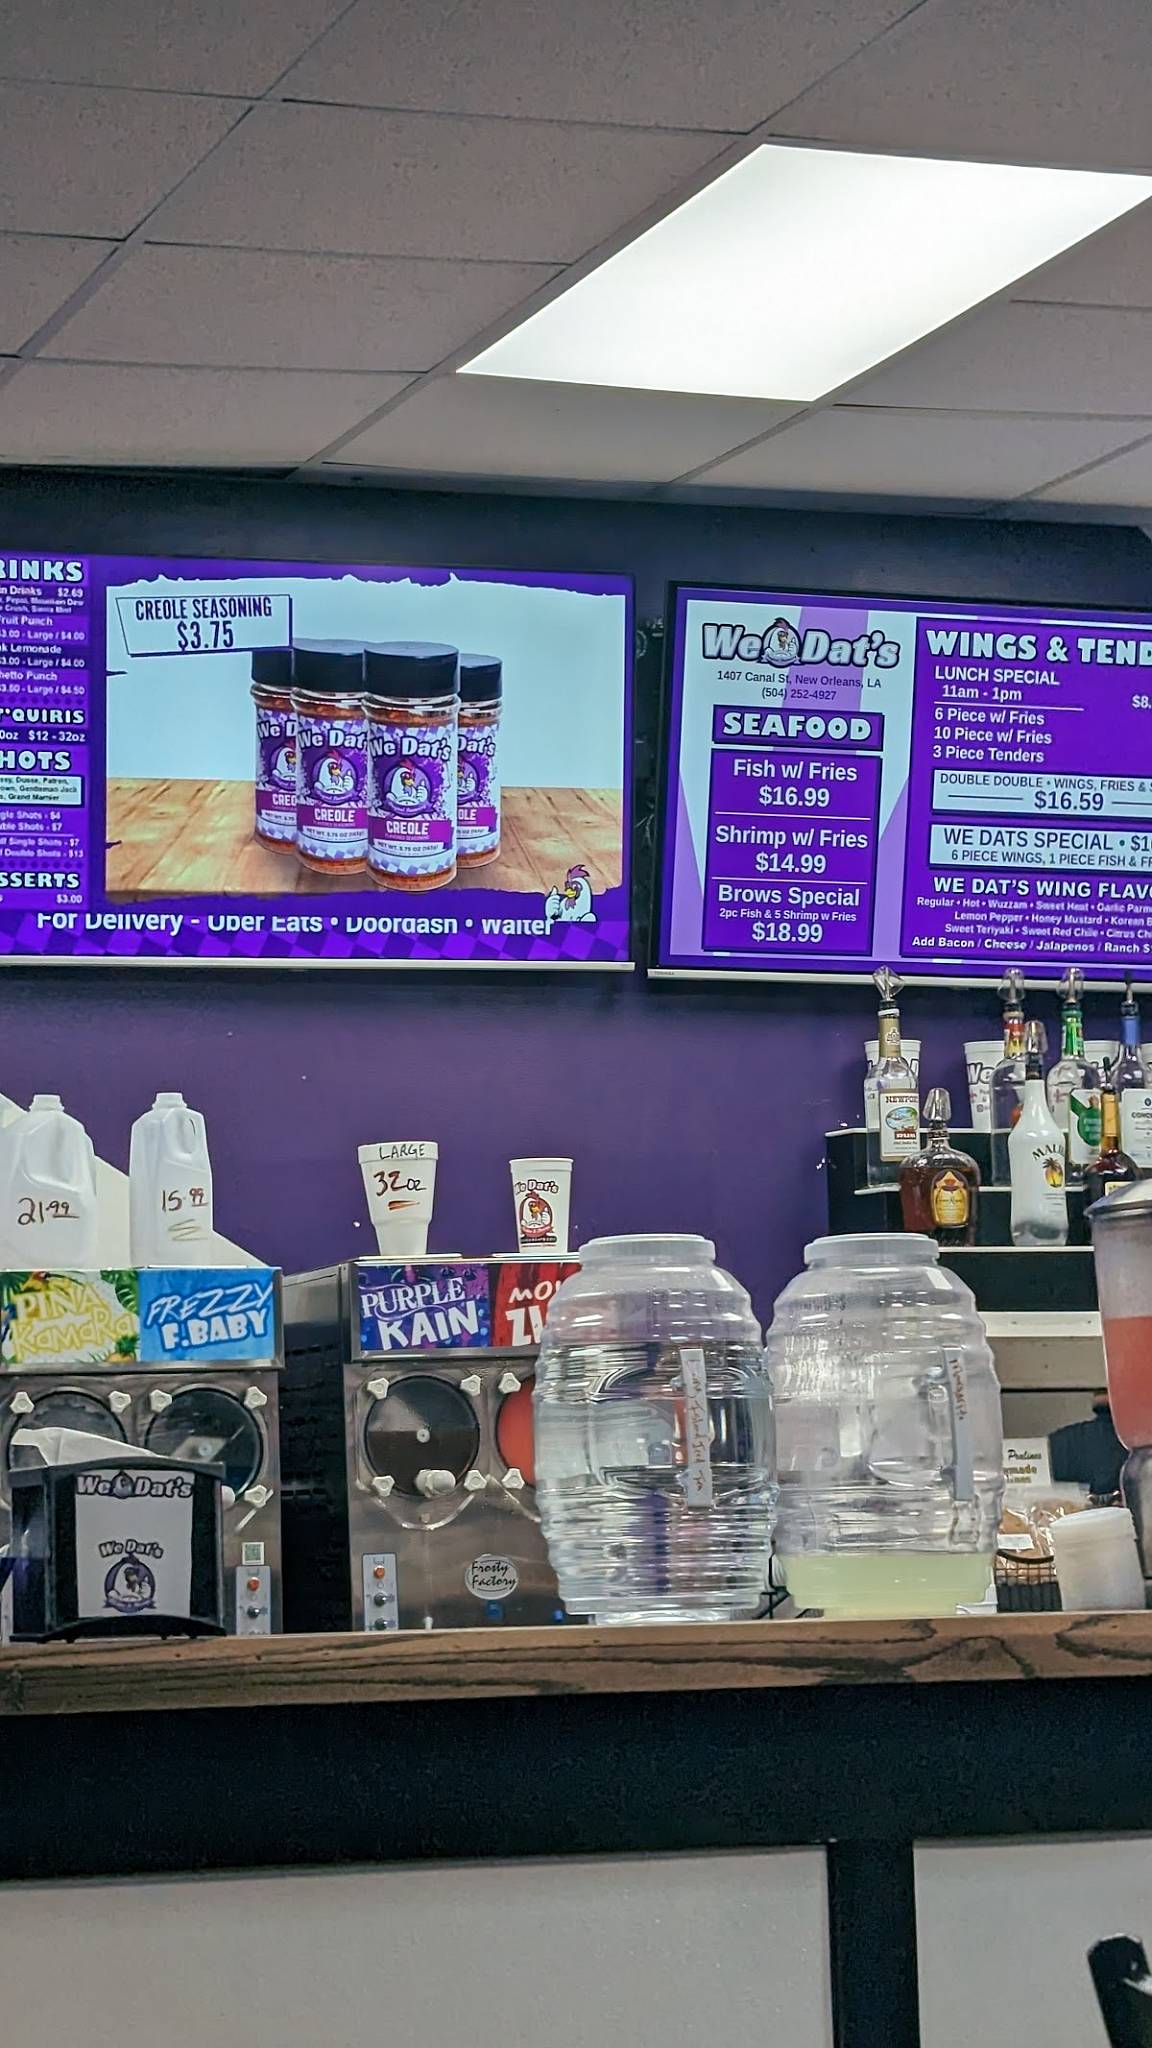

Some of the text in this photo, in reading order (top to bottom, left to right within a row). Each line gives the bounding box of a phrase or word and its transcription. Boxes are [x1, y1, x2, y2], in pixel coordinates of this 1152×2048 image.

[135, 596, 272, 621] CREOLE SEASONING
[27, 630, 54, 641] Large
[177, 620, 234, 651] $3.75
[11, 643, 62, 654] Lemonade
[702, 623, 901, 669] We Dat's
[926, 630, 1037, 660] WINGS
[1046, 636, 1069, 662] &
[27, 657, 54, 668] Large
[27, 671, 57, 681] Punch
[717, 670, 881, 688] 1407 Canal St, New Orleans, LA
[934, 665, 1060, 686] LUNCH SPECIAL
[27, 684, 54, 696] Large
[762, 687, 837, 700] (504) 252-4927
[942, 685, 1022, 703] 11am 1pm
[934, 707, 1045, 725] 6 Piece w/ Fries
[723, 711, 872, 741] SEAFOOD
[933, 726, 1052, 744] 10 Piece w/ Fries
[28, 729, 49, 742] $12
[58, 731, 86, 743] 32oz
[298, 729, 324, 749] We
[369, 735, 452, 762] We Dat's
[932, 745, 1044, 762] 3 Piece Tenders
[733, 758, 858, 781] Fish w/ Fries
[940, 773, 990, 786] DOUBLE
[993, 775, 1043, 788] DOUBLE
[1054, 777, 1098, 791] WINGS,
[1100, 779, 1135, 792] FRIES
[759, 784, 830, 807] $16.99
[1034, 790, 1104, 811] $16.59
[314, 807, 355, 822] CREOLE
[386, 820, 429, 835] CREOLE
[715, 825, 868, 849] Shrimp w/ Fries
[944, 827, 1152, 852] WE DATS SPECIAL $1
[755, 852, 827, 874] $14.99
[951, 850, 959, 861] 6
[961, 850, 998, 863] PIECE
[1001, 852, 1046, 866] WINGS,
[1049, 853, 1055, 864] 1
[1059, 853, 1095, 866] PIECE
[1098, 855, 1126, 867] FISH
[1128, 856, 1137, 867] &
[718, 884, 860, 908] Brows Special
[933, 877, 1152, 900] WE DAT'S WING FLAV
[916, 897, 955, 908] Regular
[962, 898, 980, 908] Hot
[719, 908, 738, 919] 2pc
[740, 908, 762, 919] Fish
[764, 909, 772, 919] &
[774, 909, 781, 919] 5
[783, 909, 819, 922] Shrimp
[831, 911, 857, 922] Fries
[954, 911, 987, 921] Lemon
[989, 912, 1023, 923] Pepper
[752, 921, 823, 943] $18.99
[945, 923, 974, 933] Sweet
[976, 925, 1014, 936] Teriyaki
[1052, 927, 1072, 936] Red
[912, 936, 935, 947] Add
[938, 937, 974, 948] Bacon
[984, 939, 1027, 949] Cheese
[1036, 940, 1095, 952] Jalapenos
[1104, 942, 1140, 953] Ranch
[379, 1143, 426, 1161] LARGE
[146, 1281, 274, 1327] FREZZY
[361, 1276, 466, 1320] PURPLE
[161, 1308, 268, 1350] F.BABY
[377, 1300, 480, 1351] KAIN
[76, 1475, 193, 1498] We Dat's
[471, 1560, 508, 1577] Frosty
[472, 1574, 516, 1590] Factory
